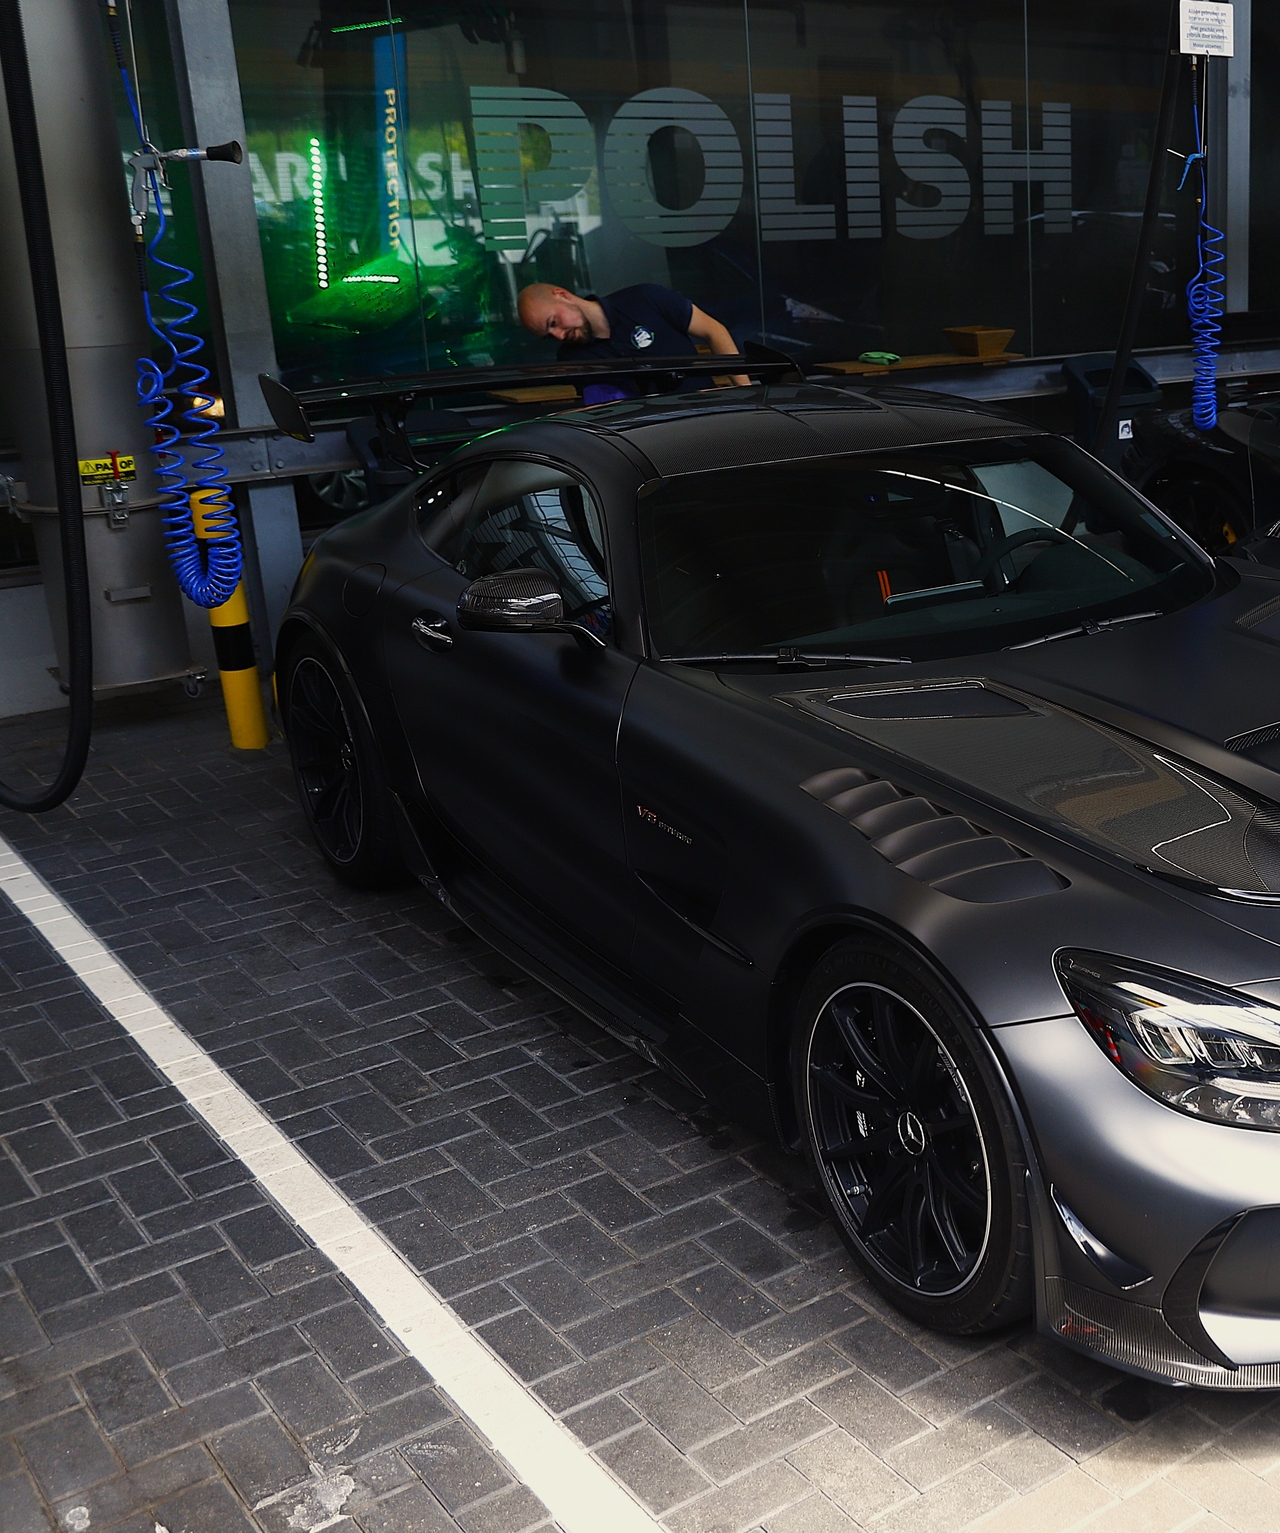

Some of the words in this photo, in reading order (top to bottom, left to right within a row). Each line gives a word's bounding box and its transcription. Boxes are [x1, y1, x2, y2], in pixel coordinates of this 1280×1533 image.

[470, 86, 1073, 252] POLISH
[120, 460, 133, 469] OP
[1081, 967, 1101, 978] AMG
